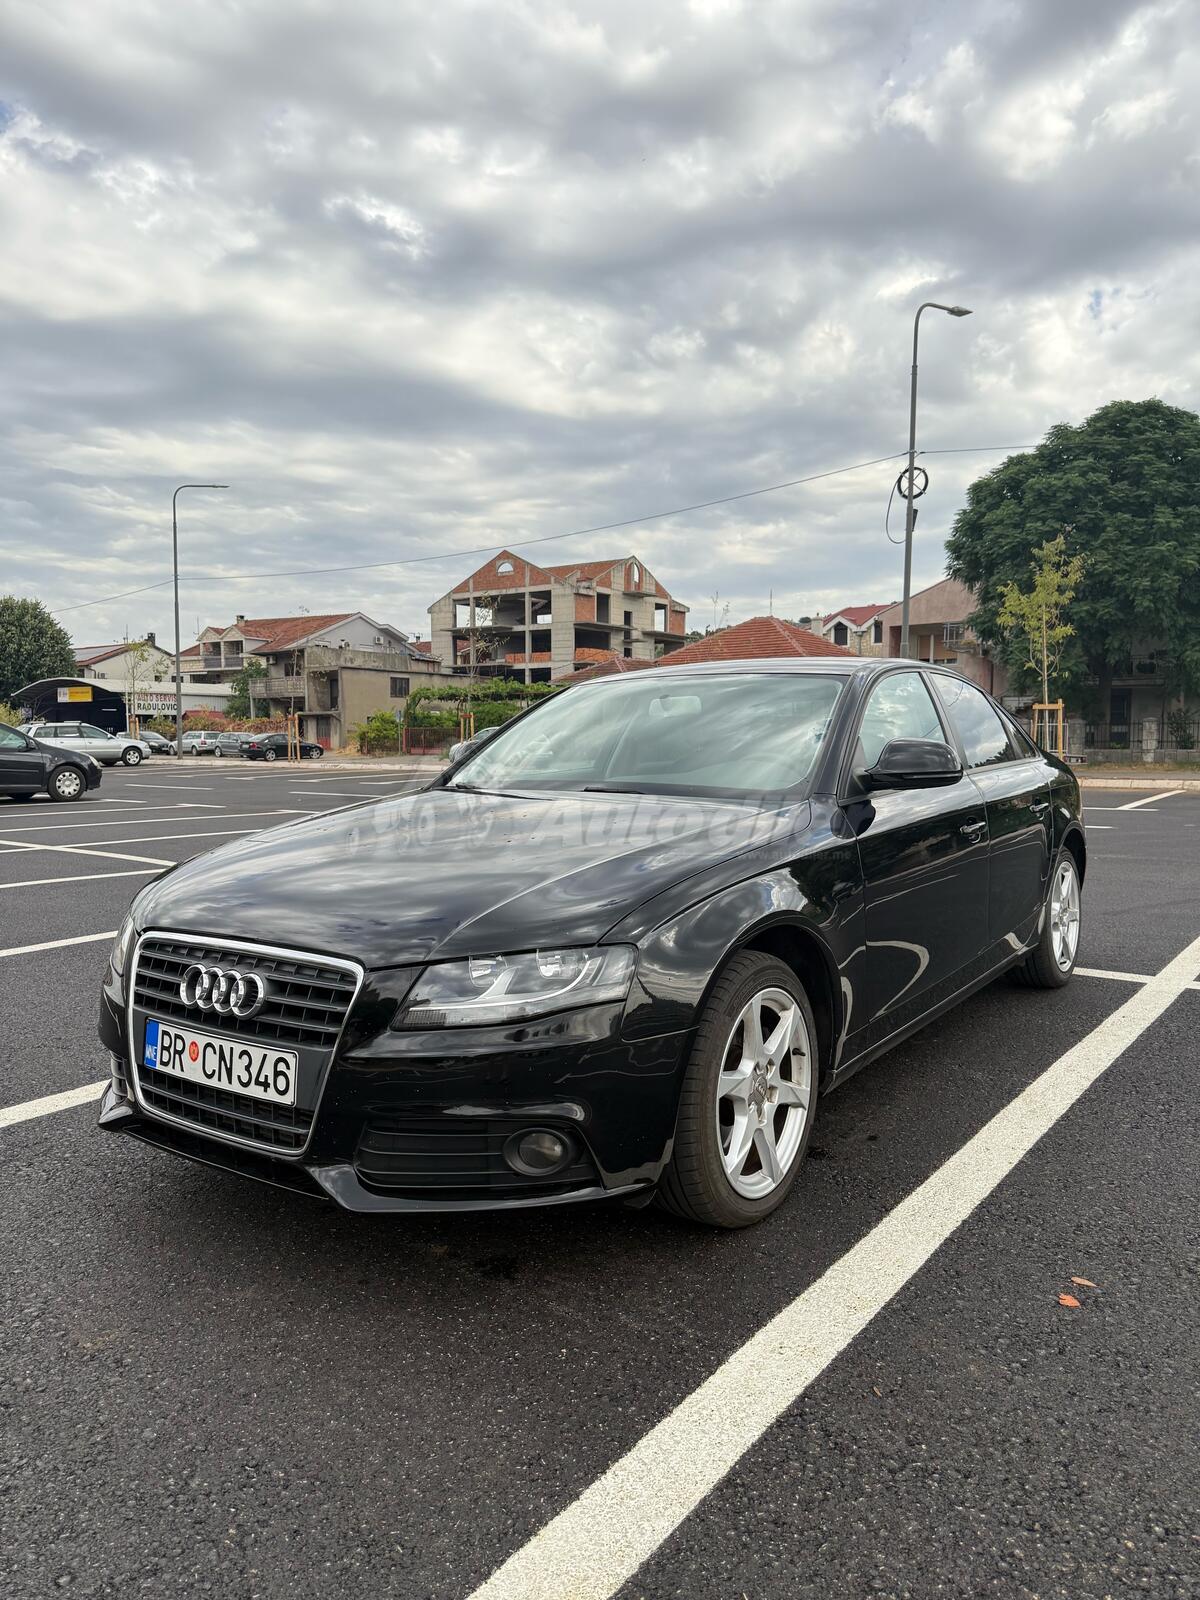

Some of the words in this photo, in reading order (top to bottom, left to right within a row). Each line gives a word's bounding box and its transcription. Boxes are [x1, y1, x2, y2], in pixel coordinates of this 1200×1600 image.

[155, 694, 177, 702] SERVIS
[160, 1029, 186, 1073] BR
[202, 1042, 291, 1096] CN346
